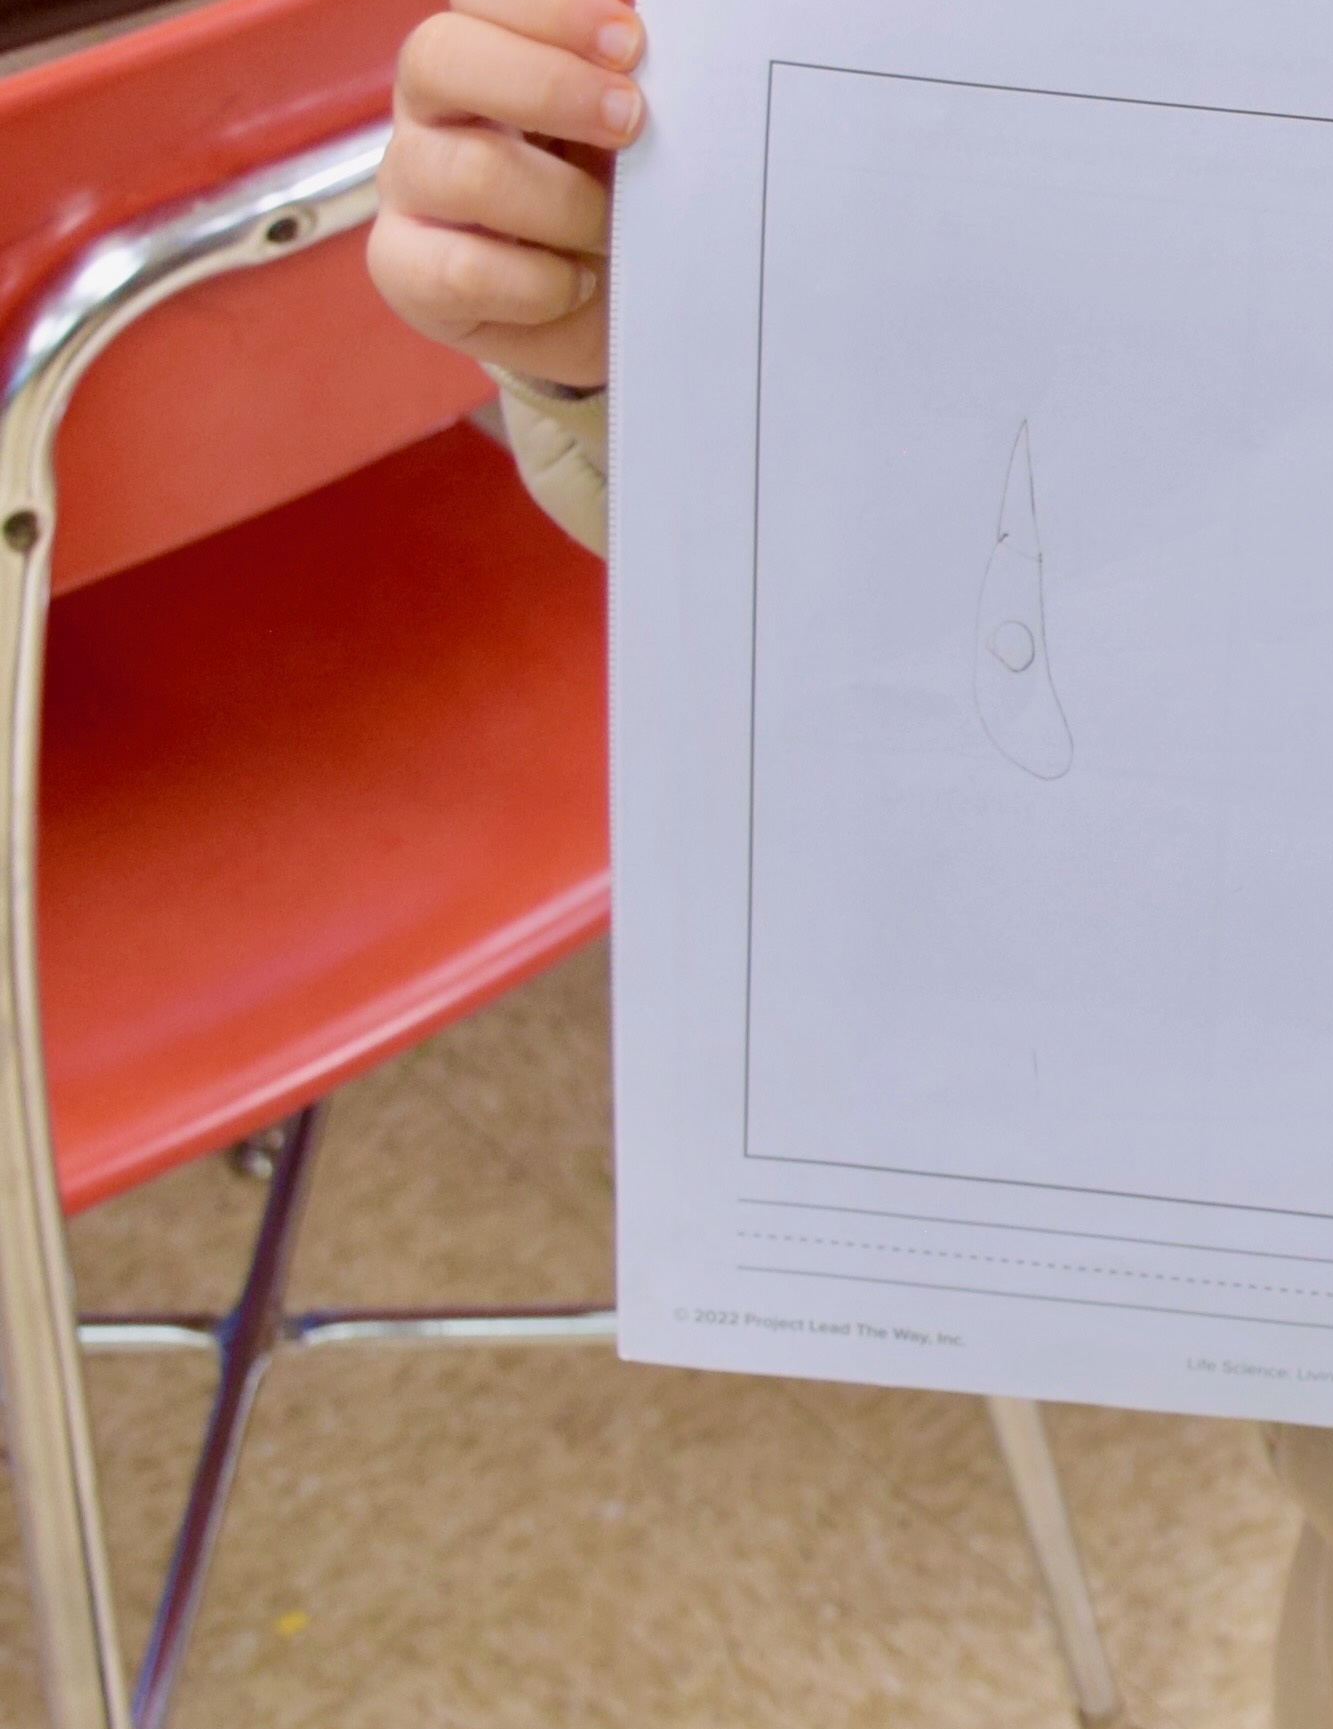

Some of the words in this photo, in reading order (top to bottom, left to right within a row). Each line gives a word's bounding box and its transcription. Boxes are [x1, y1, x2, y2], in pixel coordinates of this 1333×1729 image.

[745, 1312, 804, 1332] Project
[809, 1319, 851, 1336] Lead
[857, 1322, 888, 1339] The
[892, 1327, 932, 1346] Way,
[937, 1331, 967, 1347] Inc.
[1187, 1357, 1217, 1373] Life
